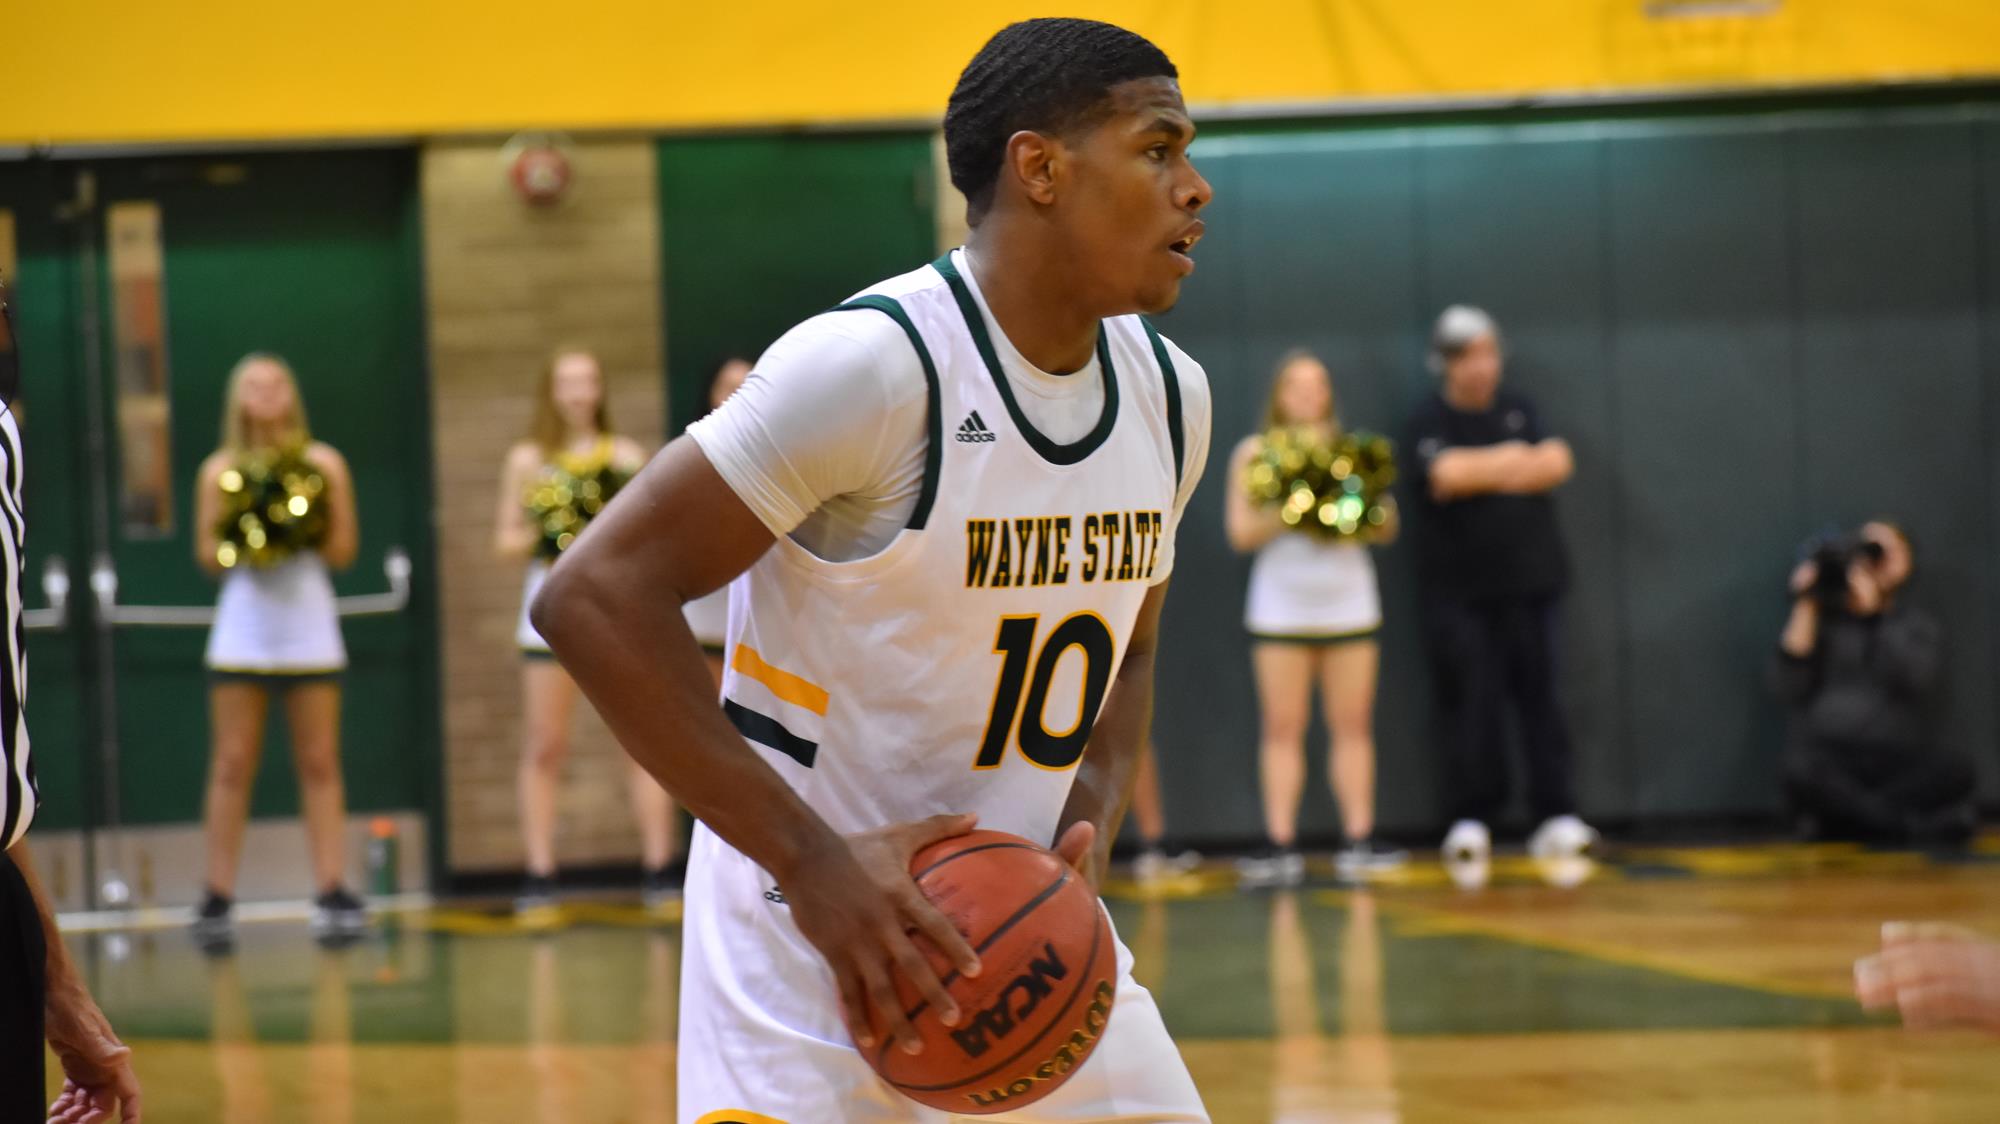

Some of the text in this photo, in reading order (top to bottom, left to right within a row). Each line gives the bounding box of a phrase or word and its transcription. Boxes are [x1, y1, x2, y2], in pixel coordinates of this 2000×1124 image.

[955, 429, 996, 443] adidas
[965, 515, 1072, 589] WAYNE
[972, 609, 1116, 772] 10
[950, 942, 1067, 1058] NCAA
